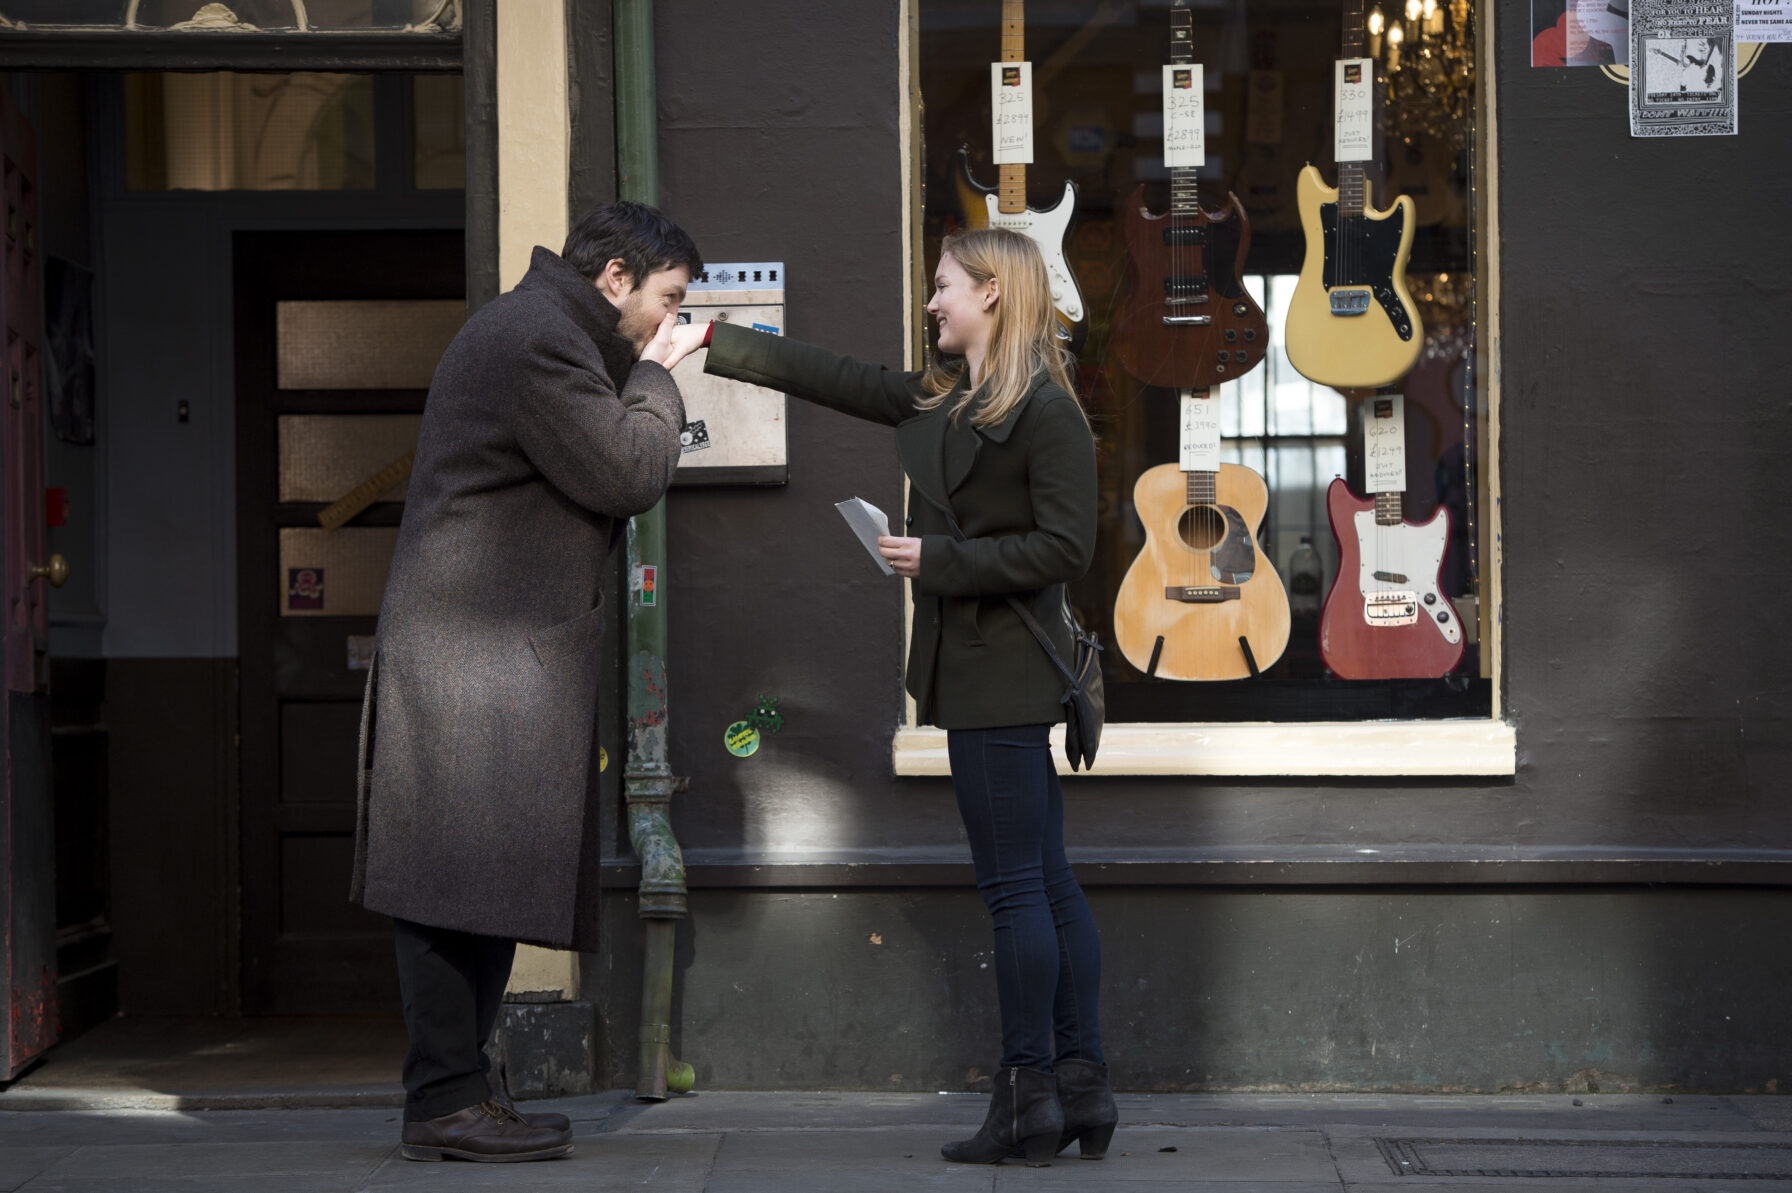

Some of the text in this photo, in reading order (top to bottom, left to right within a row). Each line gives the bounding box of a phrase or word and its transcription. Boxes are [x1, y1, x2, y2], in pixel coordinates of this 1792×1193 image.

[1695, 6, 1723, 14] HEAR
[1698, 17, 1728, 25] FEAR
[999, 91, 1025, 105] 325
[1340, 89, 1366, 101] 330
[1167, 95, 1200, 110] 325
[995, 113, 1029, 125] £2899
[1337, 109, 1368, 123] £1499
[1166, 126, 1200, 142] £2899
[1185, 404, 1209, 415] 651
[1369, 425, 1397, 437] 620
